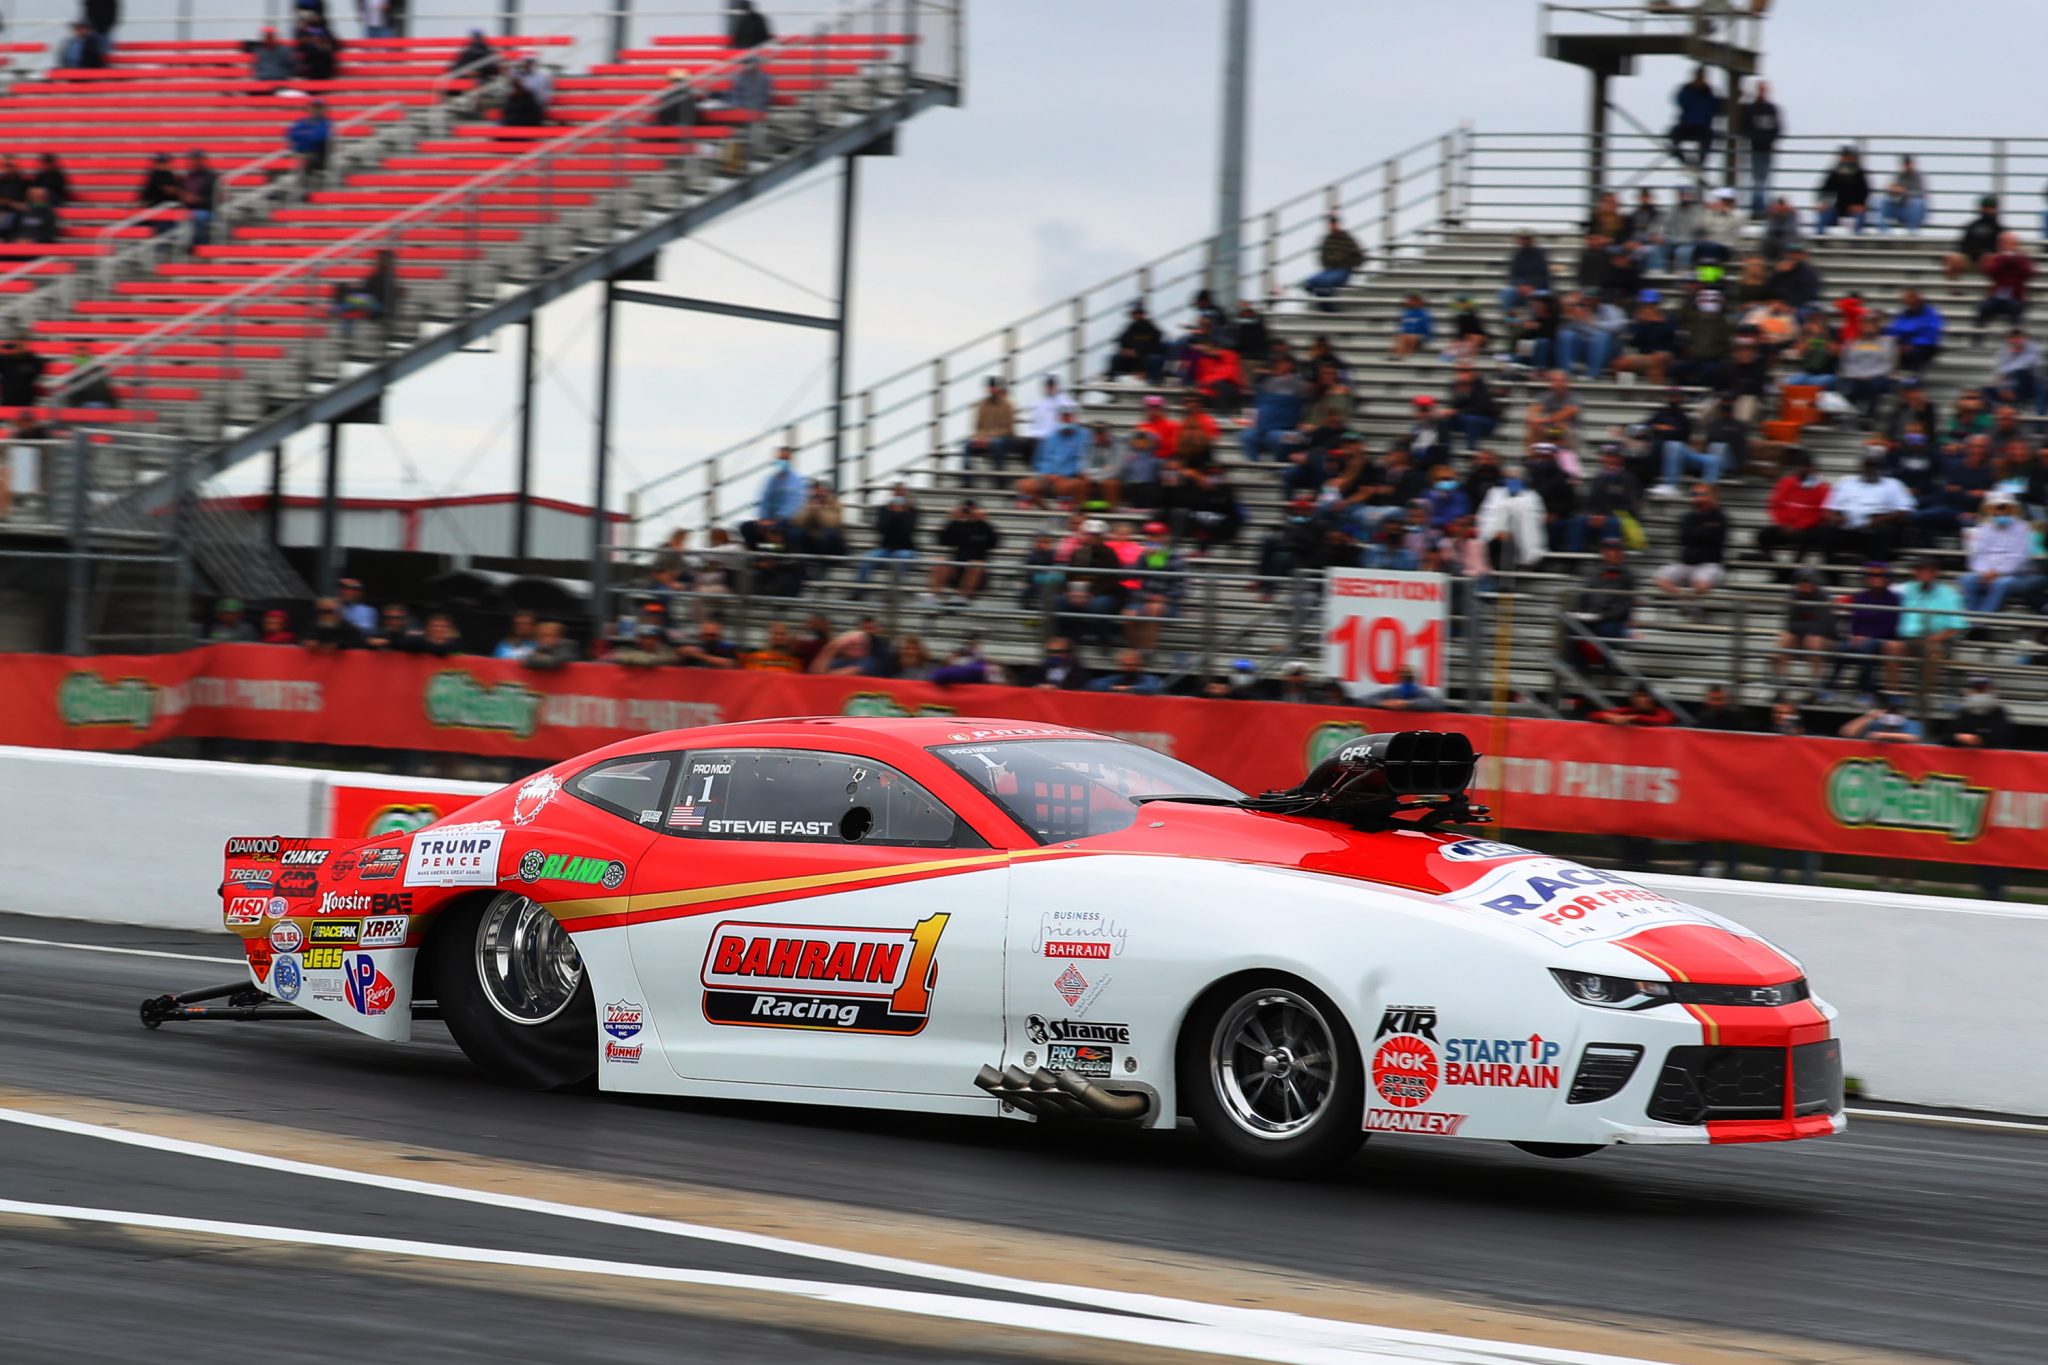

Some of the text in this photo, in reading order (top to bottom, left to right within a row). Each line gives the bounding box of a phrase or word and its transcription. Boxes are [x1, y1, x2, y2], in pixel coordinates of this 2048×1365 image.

[1330, 577, 1445, 602] SECTION
[1328, 615, 1444, 687] 101
[692, 764, 732, 774] PRO MOD
[698, 775, 714, 803] 1
[1557, 761, 1679, 804] PARTS
[708, 819, 833, 835] STEVIE FAST
[229, 839, 279, 853] DIAMOND
[421, 840, 491, 855] TRUMP
[281, 850, 330, 865] CHANCE
[421, 857, 481, 867] PENCE
[229, 869, 273, 880] TREND
[361, 863, 398, 876] DRIVE
[230, 899, 264, 916] MSD
[317, 890, 371, 914] Hoosier
[372, 893, 413, 914] BAE
[1539, 895, 1606, 926] FOR
[1053, 911, 1100, 921] BUSINESS
[272, 932, 299, 942] TOTAL SEAL
[319, 925, 357, 938] RACEPAK
[363, 920, 394, 938] XRP
[1032, 911, 1133, 957] friendly
[303, 948, 343, 968] JEGS
[1049, 944, 1108, 957] BAHRAIN
[712, 912, 952, 1014] BAHRAIN 1
[344, 954, 375, 1015] VP
[366, 985, 394, 1006] Racing
[607, 1011, 641, 1022] LUCAS
[751, 996, 860, 1026] Racing
[1050, 1018, 1130, 1044] Strange
[1374, 1009, 1440, 1045] KTR
[605, 1040, 642, 1060] SUMMIT
[1051, 1046, 1076, 1059] PRO
[1382, 1051, 1429, 1072] NGK
[1383, 1075, 1427, 1087] SPARK
[1446, 1063, 1560, 1089] BAHRAIN
[1383, 1086, 1427, 1098] PLUGS
[1368, 1111, 1456, 1133] MANLEY
